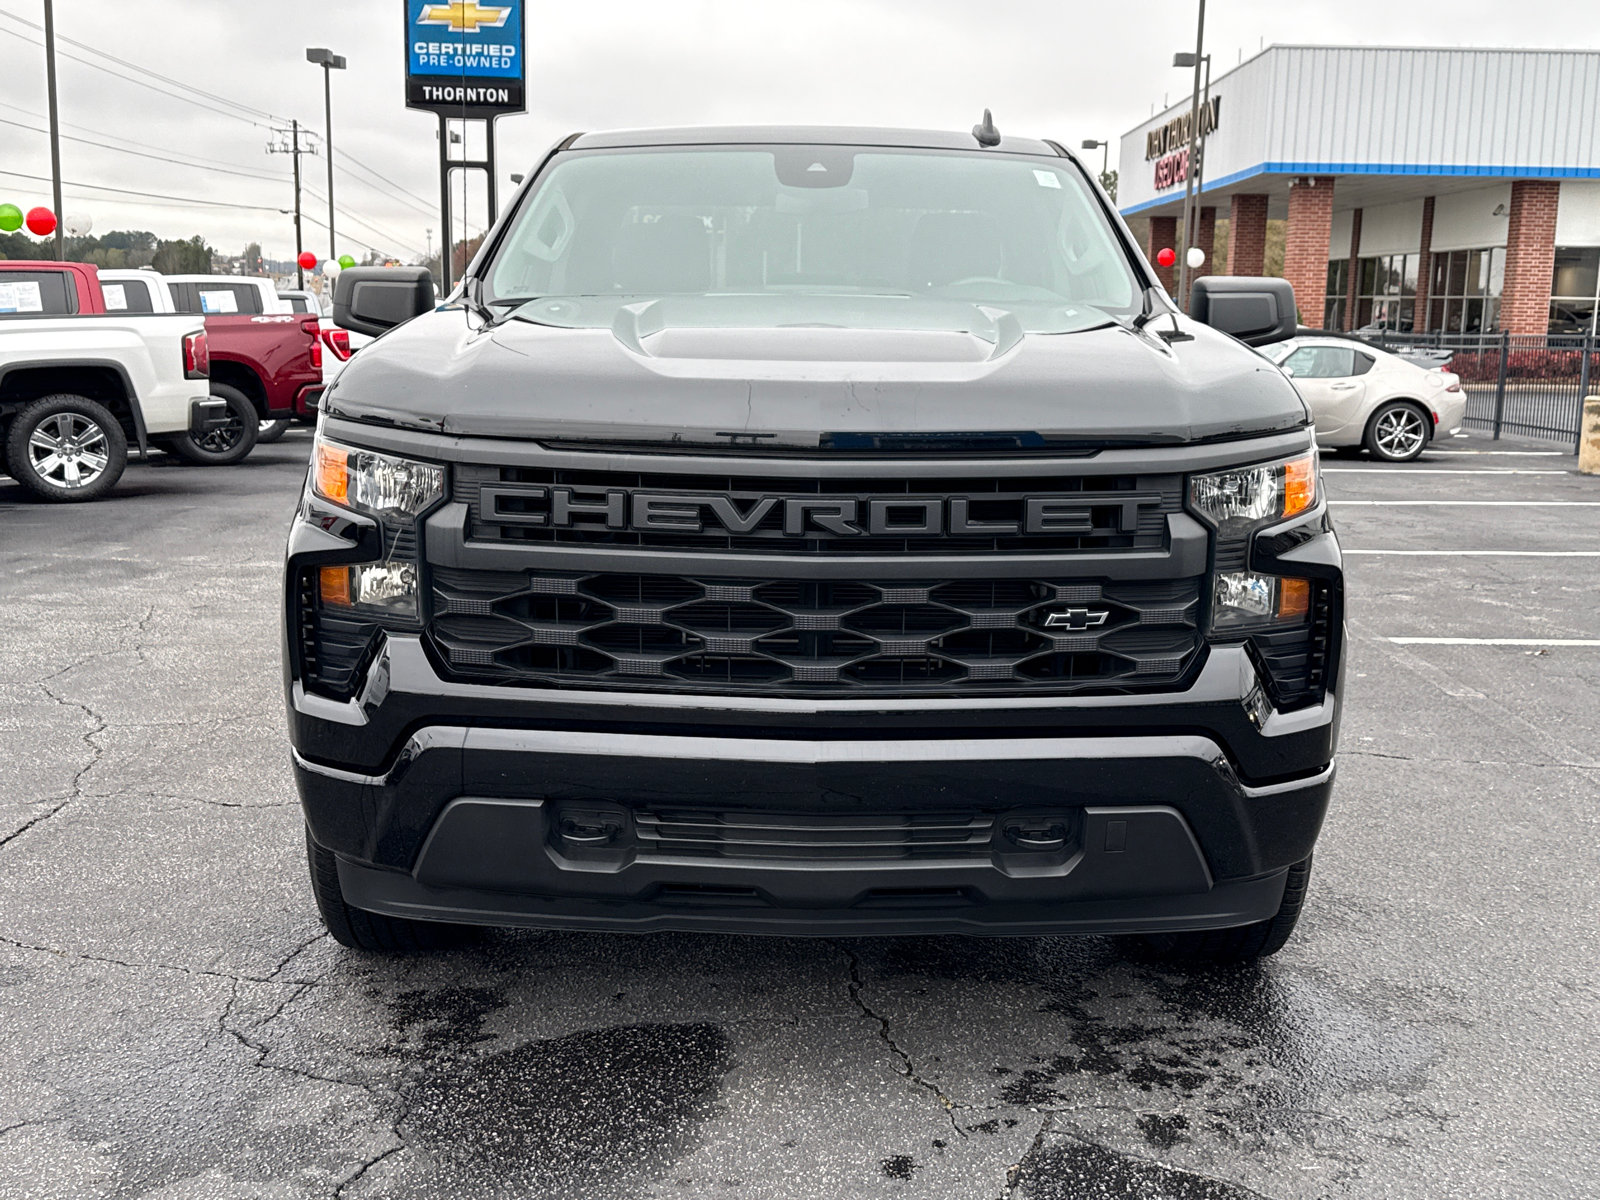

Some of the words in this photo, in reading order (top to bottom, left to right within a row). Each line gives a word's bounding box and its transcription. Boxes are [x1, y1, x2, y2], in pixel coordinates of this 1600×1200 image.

[414, 42, 516, 57] CERTIFIED
[419, 55, 511, 69] PRE-OWNED
[422, 86, 509, 103] THORNTON
[1154, 155, 1174, 190] USED
[479, 486, 1163, 536] CHEVROLET
